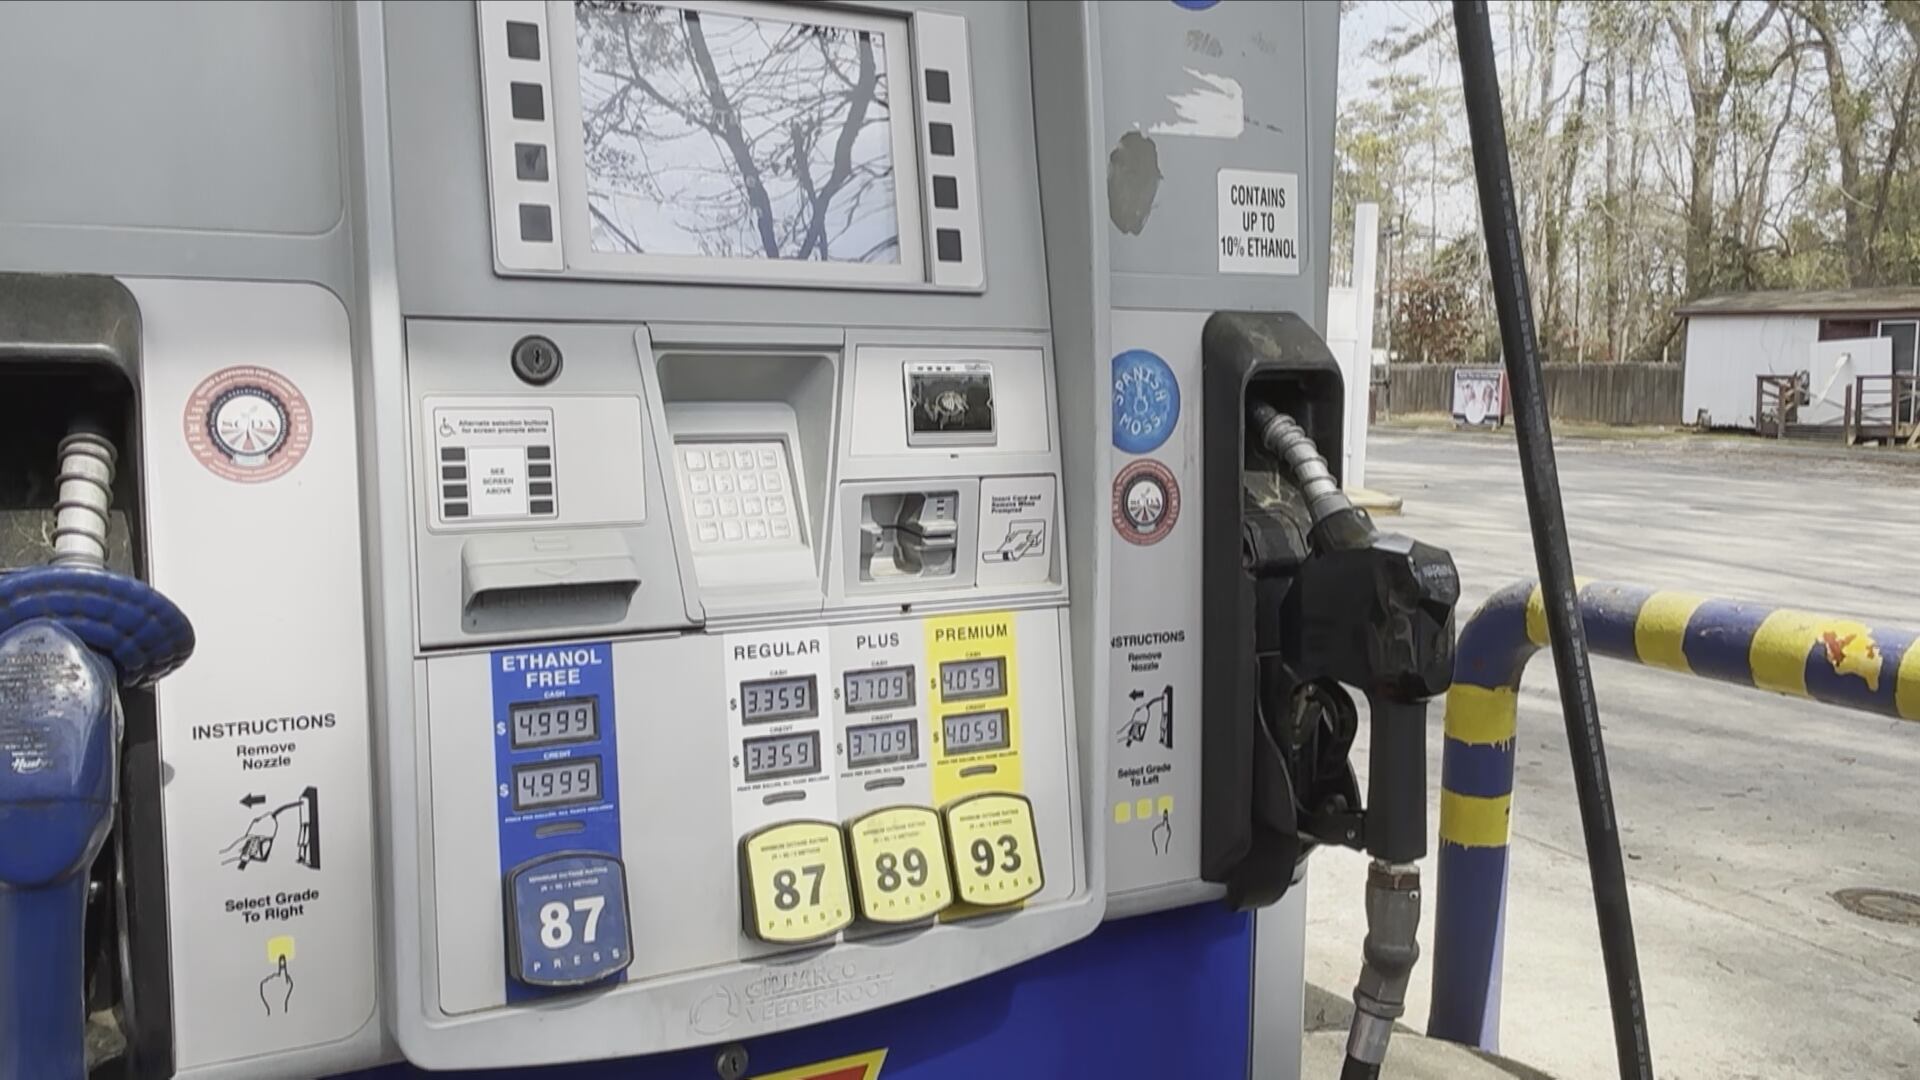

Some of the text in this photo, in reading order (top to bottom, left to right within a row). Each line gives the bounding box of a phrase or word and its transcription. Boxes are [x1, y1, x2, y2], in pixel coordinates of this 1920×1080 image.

[1230, 184, 1286, 208] CONTAINS
[1242, 211, 1275, 233] UP TO
[1221, 235, 1297, 259] 10% ETHANOL
[1113, 366, 1167, 407] SPANISH
[1119, 413, 1160, 435] MOSS
[482, 477, 514, 486] SCREEN
[490, 467, 505, 476] SEE
[485, 487, 511, 496] ABOVE
[856, 632, 900, 650] PLUS
[935, 623, 1008, 643] PREMIUM
[1111, 630, 1185, 648] NSTRUCTIONS
[502, 648, 602, 672] ETHANOL
[734, 639, 821, 660] REGULAR
[1128, 651, 1162, 663] Remove
[1131, 661, 1159, 672] Nozzle
[526, 668, 581, 689] FREE
[833, 676, 903, 703] $ 3.709
[930, 666, 995, 691] $ 4.059
[543, 690, 566, 699] CASH
[730, 685, 805, 714] $ 3.359
[192, 713, 336, 741] INSTRUCTIONS
[496, 708, 588, 737] $ 4.999
[933, 719, 998, 745] $ 4.059
[236, 741, 297, 758] Remove
[836, 729, 906, 757] $ 3.709
[242, 755, 291, 771] Nozzle
[543, 750, 571, 761] CREDIT
[732, 741, 809, 771] $ 3.359
[1117, 762, 1172, 779] Select Grade
[1130, 775, 1160, 787] To Left
[499, 768, 590, 798] $ 4.999
[970, 834, 1022, 877] 93
[875, 847, 929, 893] 89
[773, 863, 826, 912] 87
[969, 876, 1034, 894] PRESS
[225, 889, 320, 913] Select Grade
[873, 889, 941, 911] PRESS
[242, 904, 304, 923] To Right
[539, 895, 606, 949] 87
[768, 909, 843, 929] PRESS
[533, 948, 620, 972] PRESS
